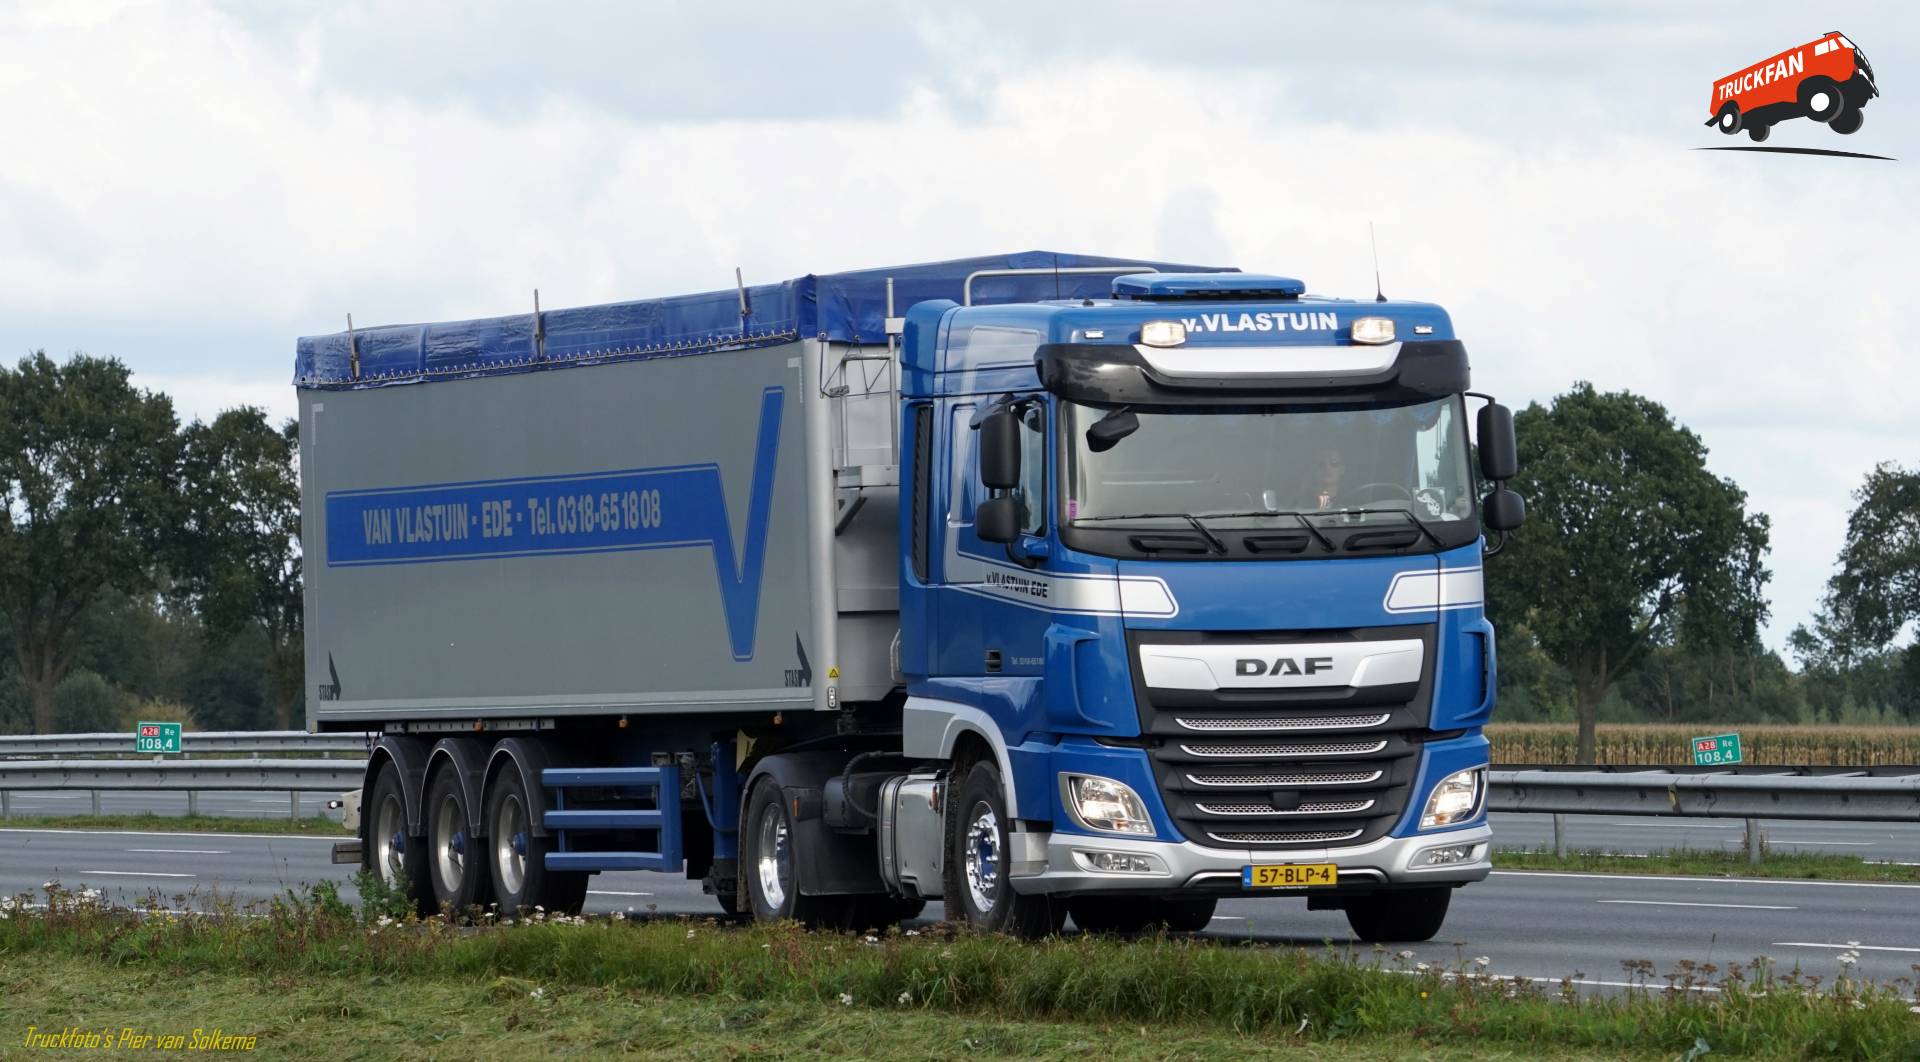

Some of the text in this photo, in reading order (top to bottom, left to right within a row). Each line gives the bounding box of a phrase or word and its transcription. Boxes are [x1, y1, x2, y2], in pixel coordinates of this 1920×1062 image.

[1181, 312, 1338, 333] v.VLASTUIN
[362, 507, 392, 545] VAN
[396, 503, 469, 543] VLASTUIN
[482, 499, 513, 538] EDE
[1030, 580, 1049, 598] EDE
[1235, 656, 1334, 677] DAF
[142, 727, 175, 736] A28 Re
[140, 738, 173, 751] 108,4
[1698, 741, 1716, 751] A28
[1259, 867, 1331, 884] 57-BLP-4
